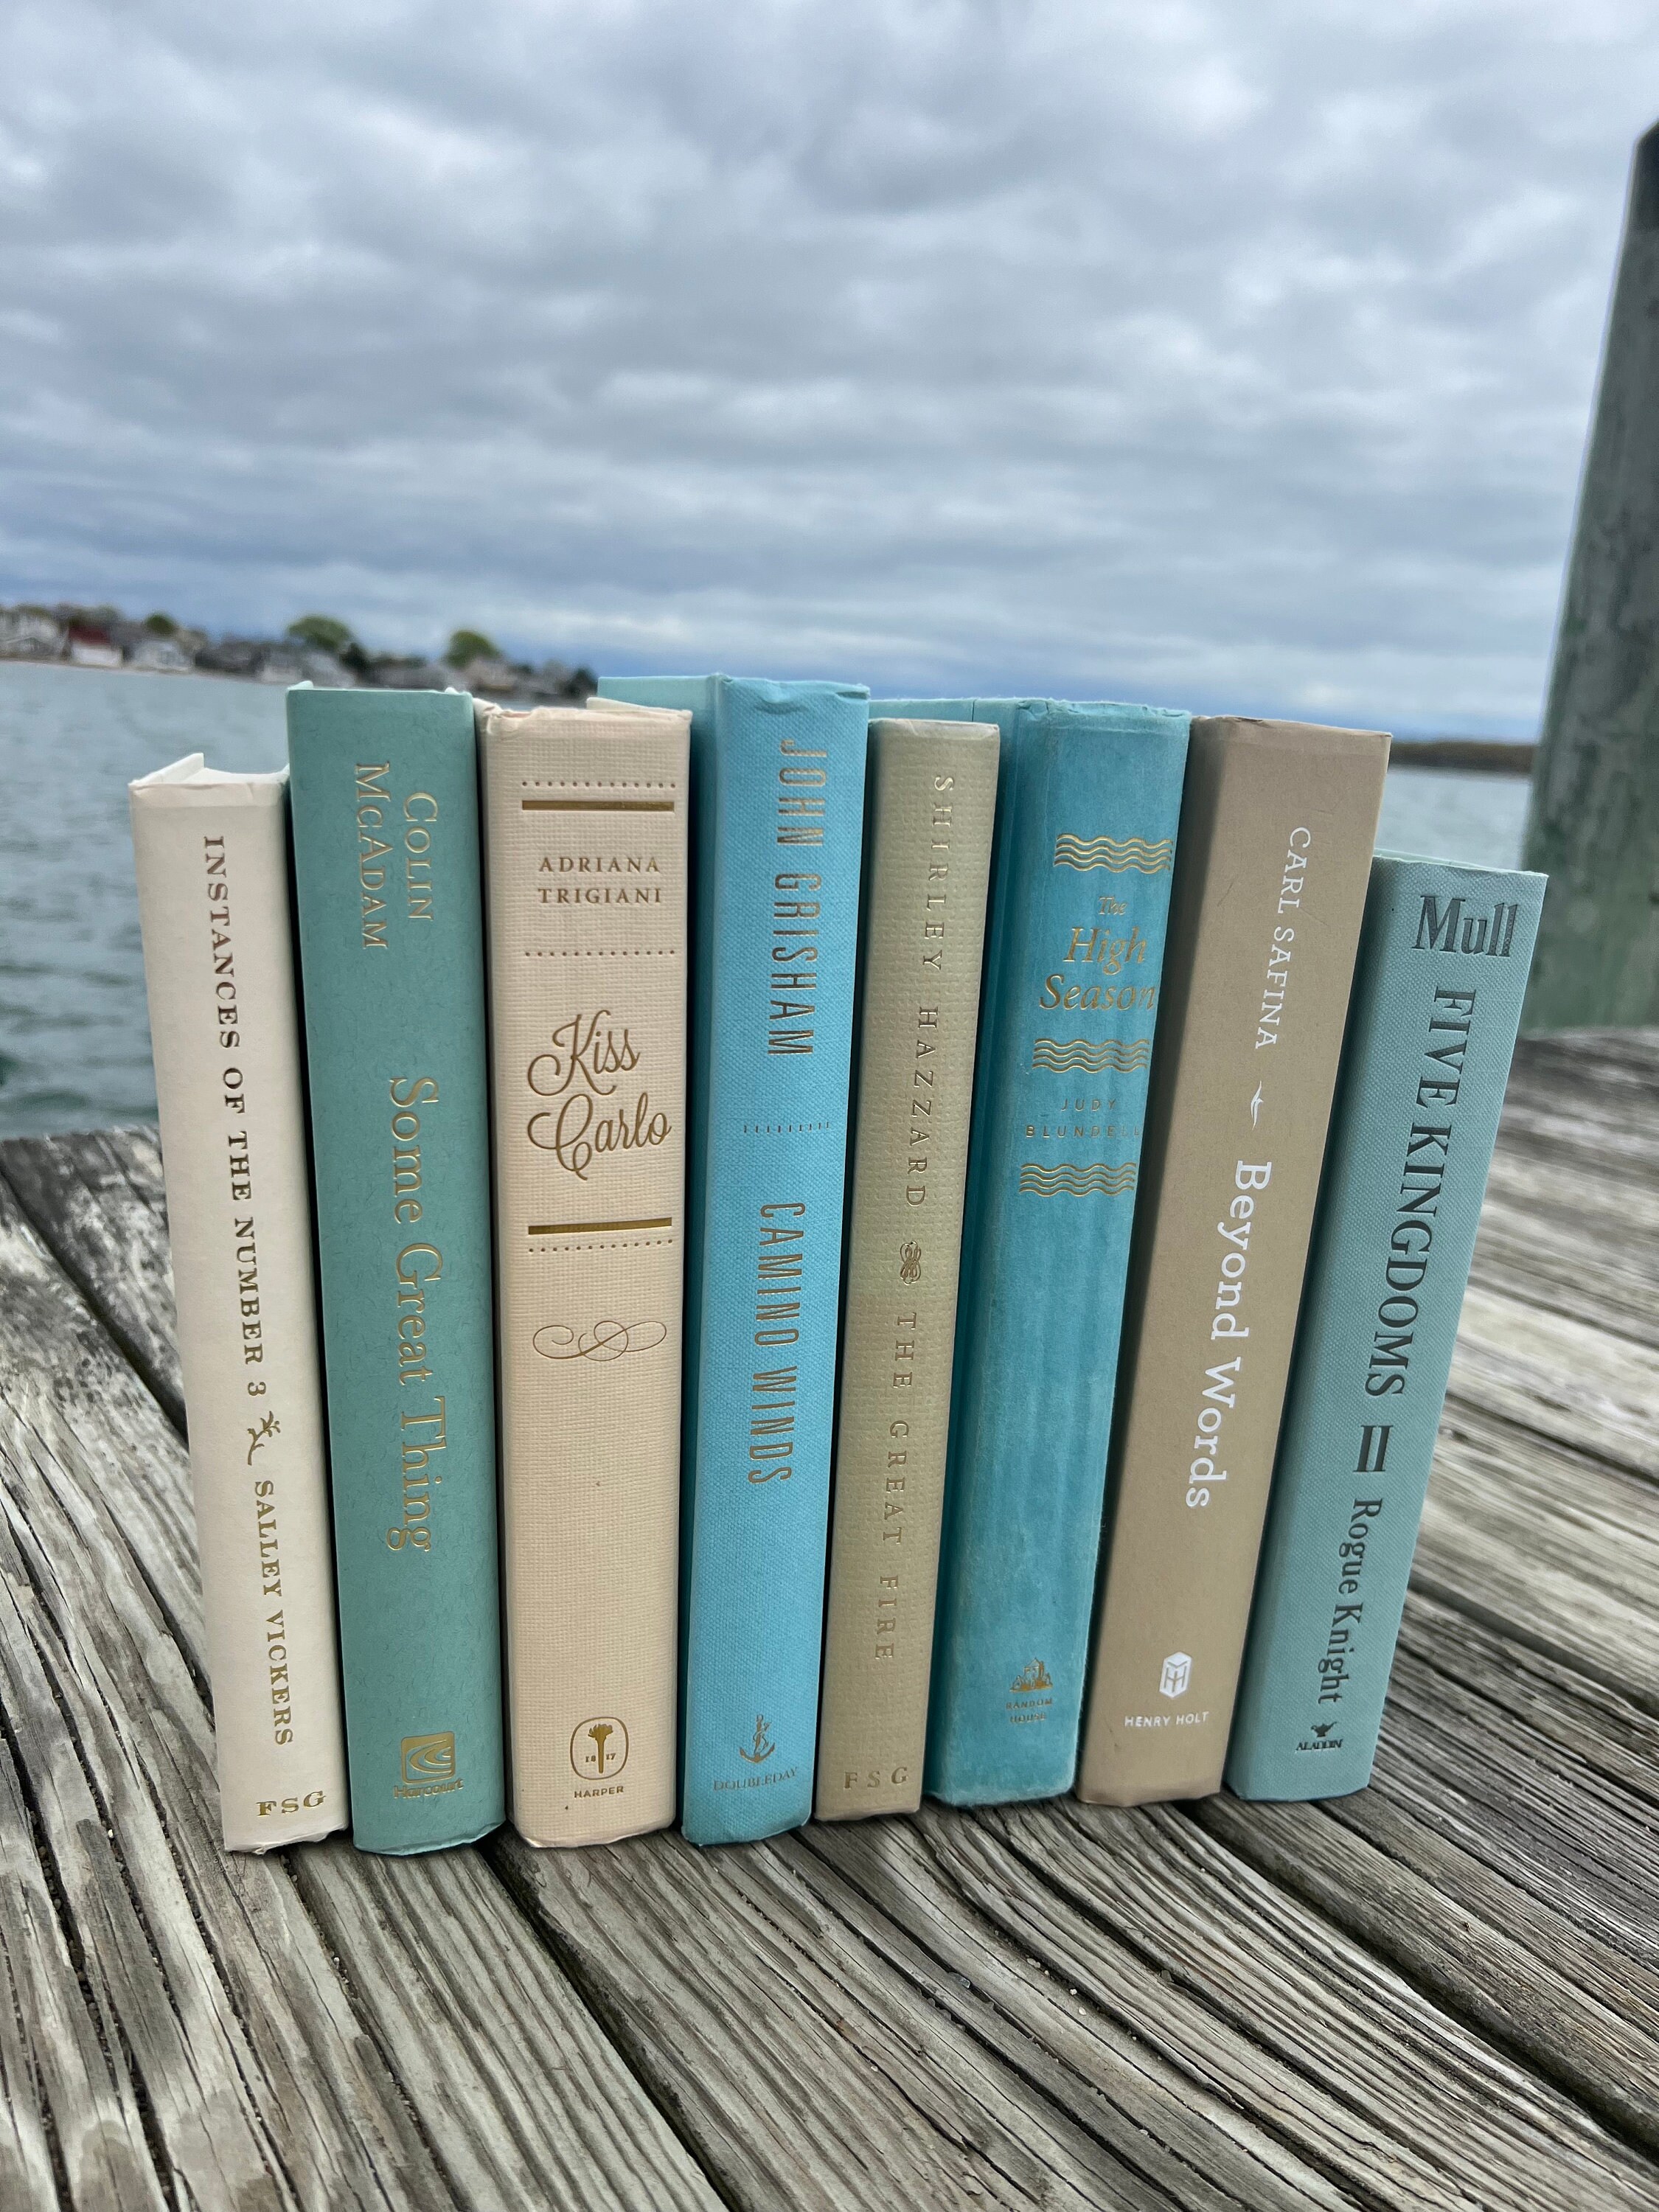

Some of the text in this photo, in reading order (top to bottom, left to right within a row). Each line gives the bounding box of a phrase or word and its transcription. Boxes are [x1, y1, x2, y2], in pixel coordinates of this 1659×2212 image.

[538, 856, 661, 874] ADRIANA
[538, 887, 662, 905] TRIGIANI
[768, 740, 828, 1056] JOHN GRISHAM
[1098, 895, 1128, 915] The
[1062, 926, 1147, 975] High
[1255, 827, 1312, 1050] CARL SAFINA
[1411, 895, 1519, 958] Mull
[907, 775, 955, 1208] SHIRLEY HAZZARD
[1039, 973, 1155, 1011] Season
[527, 1009, 641, 1096] Kiss
[203, 835, 267, 1397] INSTANCES OF THE NUMBER 3
[1060, 1098, 1117, 1112] JUDY
[528, 1093, 672, 1180] Carlo
[1025, 1125, 1141, 1139] BLUNDELL
[1364, 985, 1476, 1397] FIVE KINGDOMS
[386, 1077, 447, 1553] Some Great Thing
[1185, 1161, 1272, 1509] Beyond Words
[748, 1203, 806, 1485] CAMINO WINDS
[874, 1312, 917, 1660] THE GREAT FIRE
[254, 1480, 294, 1747] SALLEY VICKERS
[1318, 1498, 1383, 1705] Rogue Knight
[1005, 1697, 1053, 1709] RANDOM
[1009, 1713, 1046, 1723] HOUSE
[1124, 1711, 1209, 1727] HENRY HOLT
[1295, 1738, 1343, 1751] ALADDIN
[393, 1778, 464, 1799] Harcourt
[574, 1785, 625, 1798] HARPER
[712, 1767, 798, 1791] DOUBLEDAY
[256, 1790, 326, 1818] FSG
